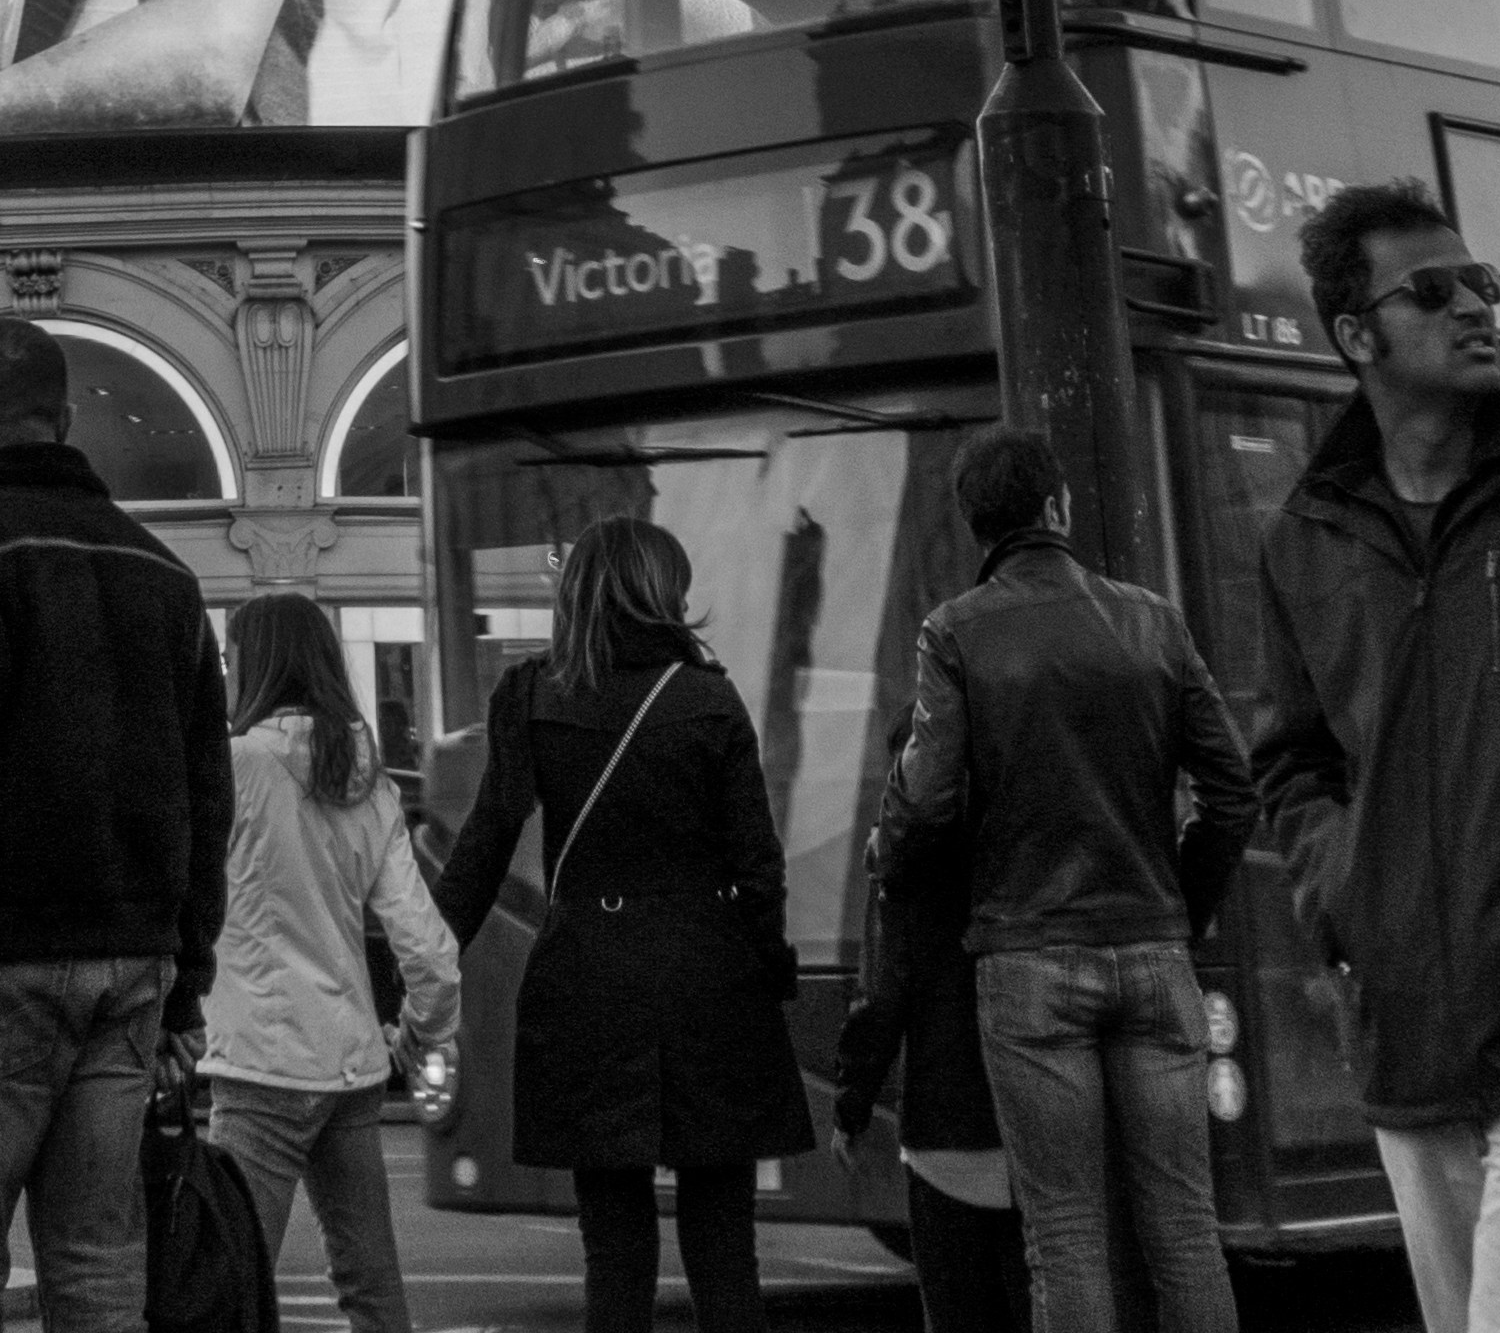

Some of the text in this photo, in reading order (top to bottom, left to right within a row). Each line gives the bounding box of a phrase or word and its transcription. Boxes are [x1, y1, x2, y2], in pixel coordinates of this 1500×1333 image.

[525, 169, 950, 305] Victoria 38
[1242, 312, 1268, 341] LT
